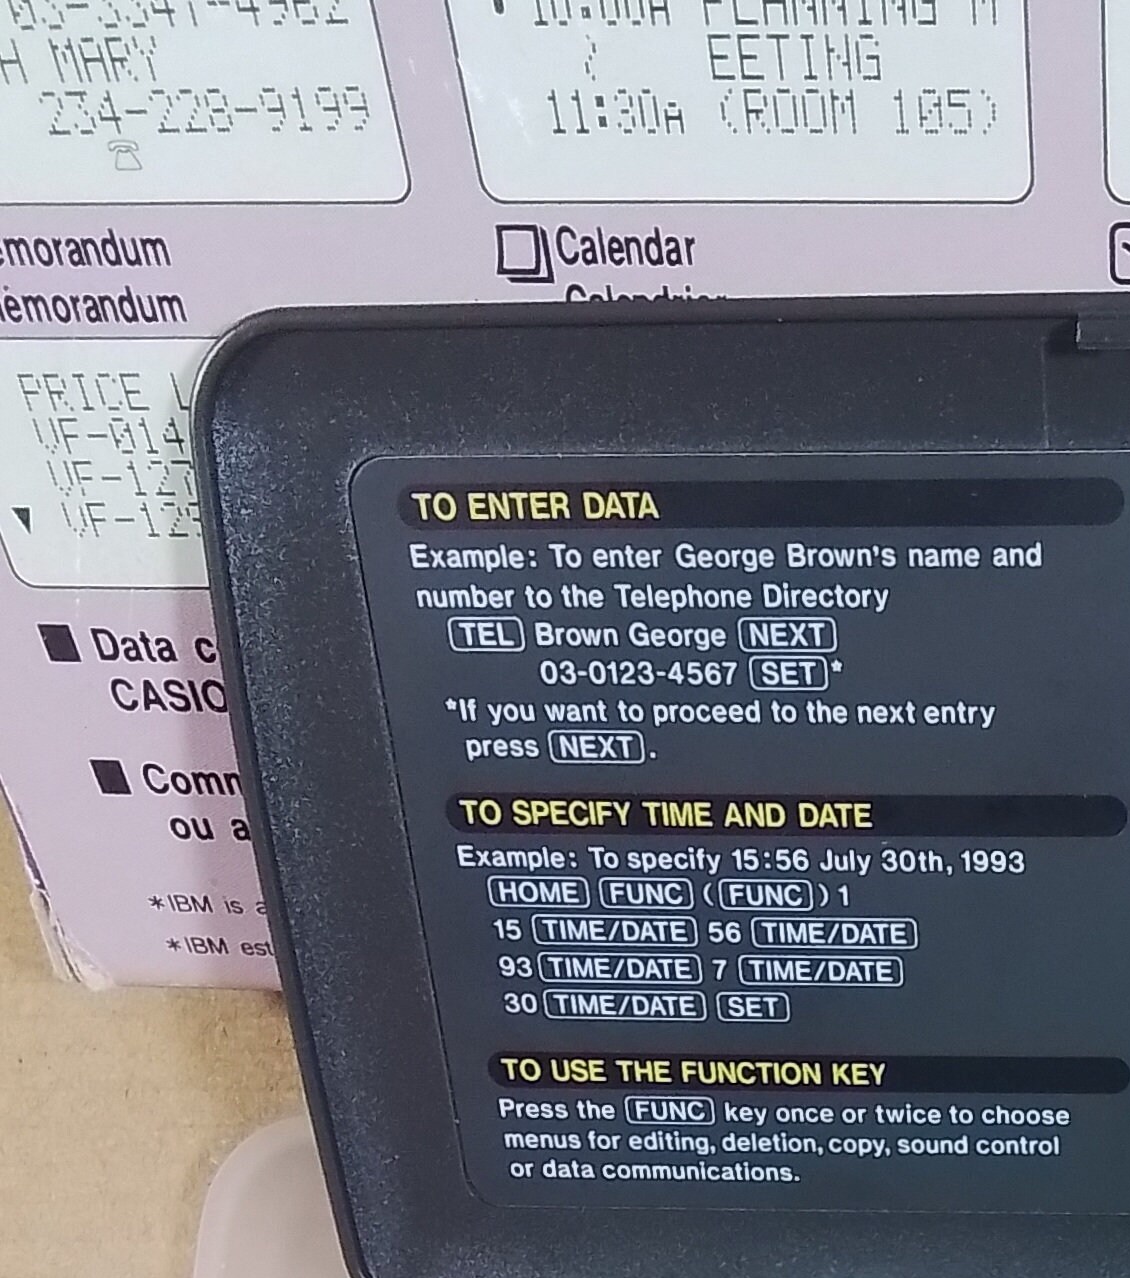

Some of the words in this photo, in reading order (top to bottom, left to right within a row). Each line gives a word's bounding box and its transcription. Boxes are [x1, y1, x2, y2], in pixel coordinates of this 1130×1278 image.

[48, 35, 157, 83] MARY
[706, 33, 882, 81] EETING
[39, 85, 369, 135] 234-228-9199
[0, 227, 172, 267] morandum
[556, 226, 695, 266] Calendar
[17, 372, 150, 411] PRICE
[411, 493, 456, 520] TO
[468, 492, 570, 519] ENTER
[583, 492, 659, 518] DATA
[410, 544, 536, 572] Example:
[549, 544, 581, 567] To
[593, 545, 661, 568] enter
[676, 544, 774, 572] George
[788, 544, 896, 567] Brown's
[909, 548, 979, 567] name
[993, 542, 1041, 567] and
[90, 627, 178, 662] Data
[459, 622, 514, 645] TEL
[535, 623, 618, 646] Brown
[629, 623, 726, 650] George
[750, 623, 825, 646] NEXT
[541, 661, 737, 685] 03-0123-4567
[110, 678, 228, 713] CASIO
[169, 817, 215, 840] ou
[459, 800, 501, 825] TO
[513, 800, 630, 826] SPECIFY
[642, 802, 713, 826] TIME
[725, 803, 785, 827] AND
[799, 803, 872, 827] DATE
[457, 845, 576, 871] Example:
[588, 847, 618, 868] To
[628, 847, 720, 874] specify
[732, 849, 809, 871] 15:56
[820, 850, 870, 875] July
[882, 850, 952, 875] 30th,
[961, 851, 1024, 873] 1993
[224, 896, 244, 914] is
[240, 940, 275, 956] est
[505, 1134, 581, 1148] menus
[588, 1131, 620, 1149] for
[629, 1131, 715, 1154] editing,
[722, 1133, 823, 1155] deletion,
[829, 1139, 890, 1157] copy,
[898, 1136, 968, 1154] sound
[977, 1136, 1059, 1154] control
